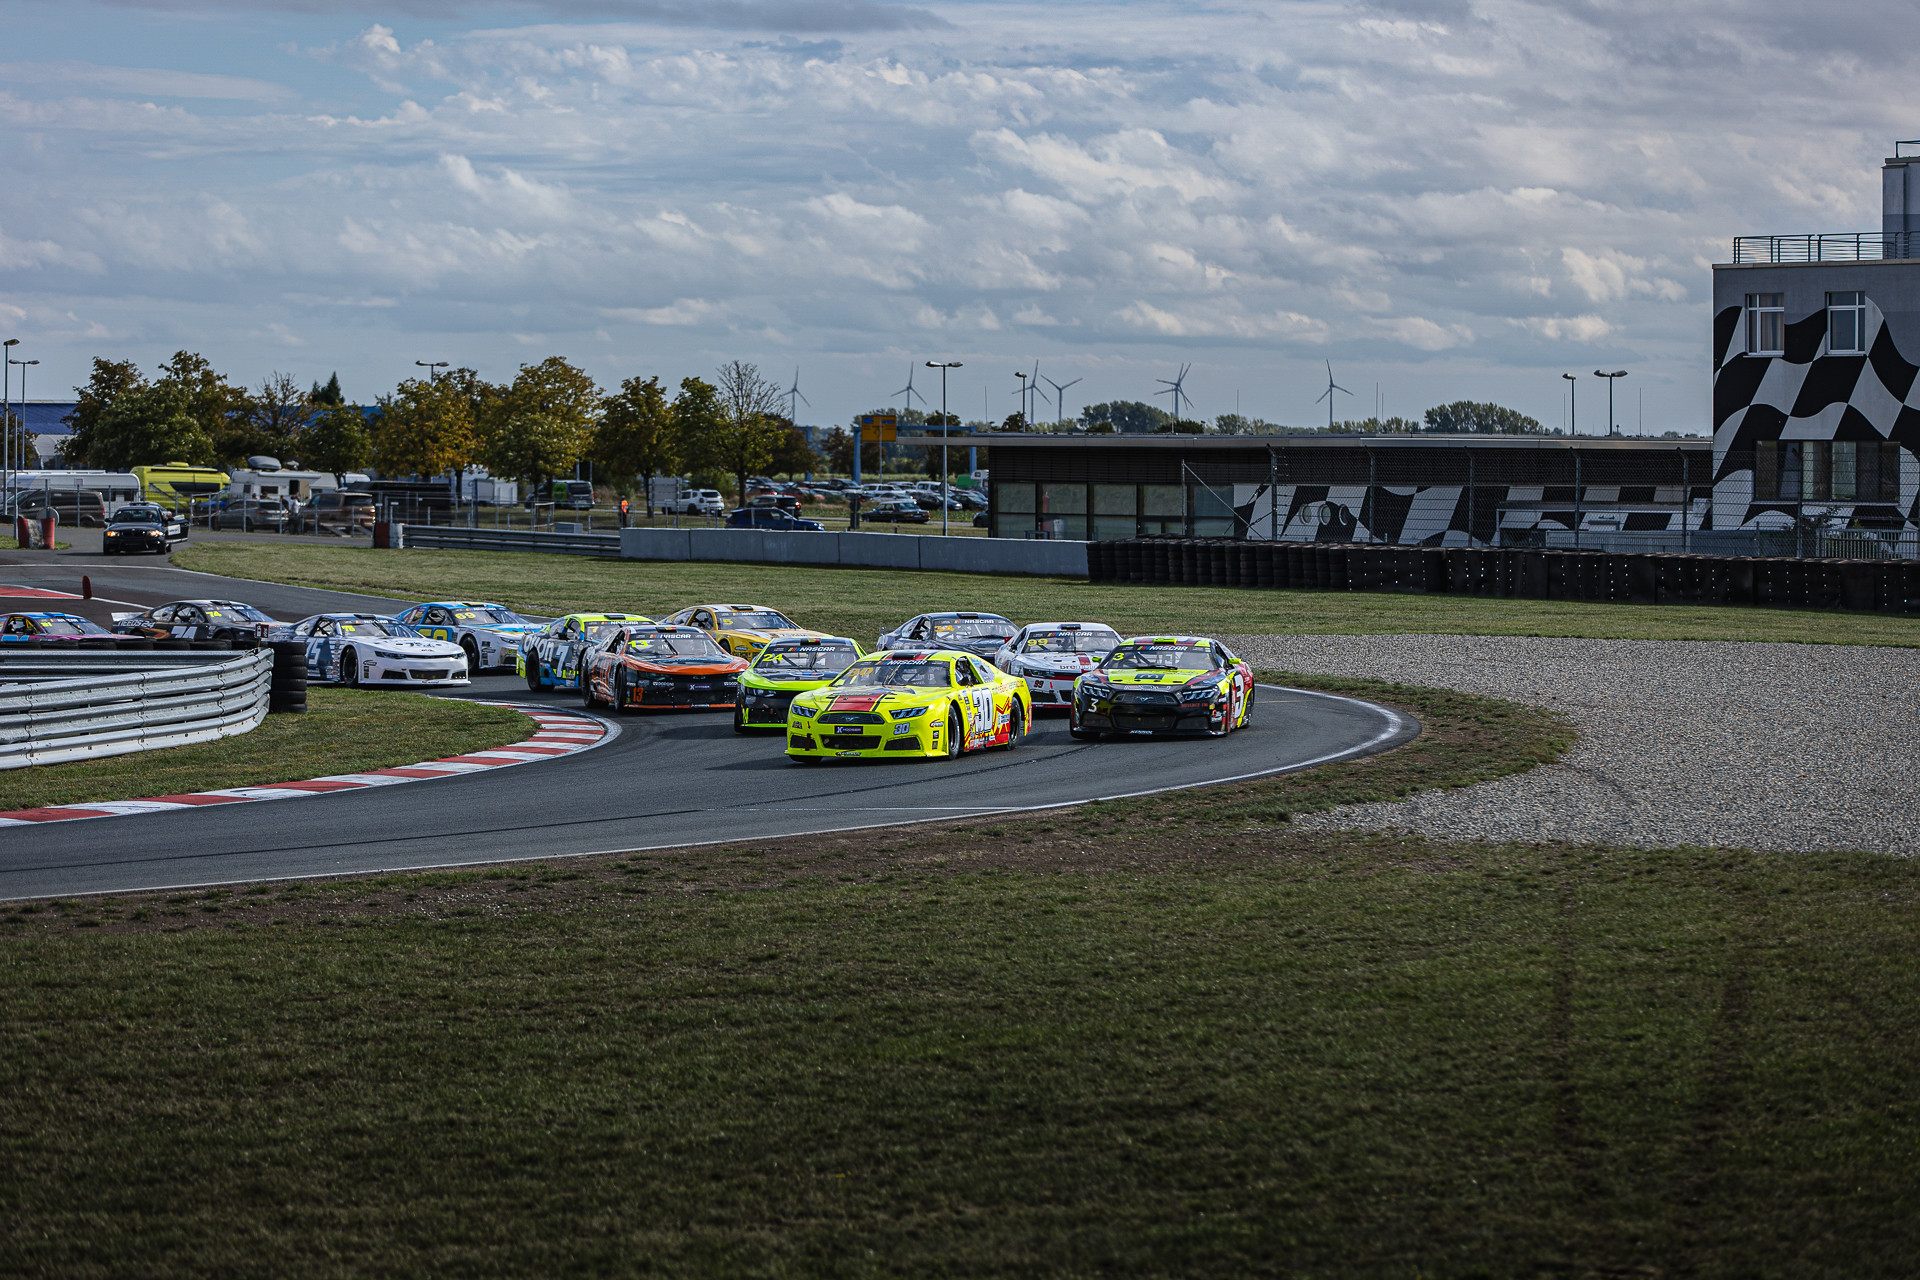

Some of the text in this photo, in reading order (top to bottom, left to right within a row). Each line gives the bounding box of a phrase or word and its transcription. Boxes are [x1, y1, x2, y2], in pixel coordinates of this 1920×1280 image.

[627, 640, 648, 648] 13
[1027, 638, 1048, 646] 99
[555, 644, 570, 678] 7
[763, 653, 784, 662] 24
[1113, 652, 1124, 661] 3
[845, 667, 874, 677] 30
[1033, 679, 1045, 688] 99
[633, 687, 644, 702] 13
[1233, 673, 1245, 719] 3
[972, 687, 994, 735] 30
[1087, 698, 1099, 713] 3
[894, 723, 910, 735] 30
